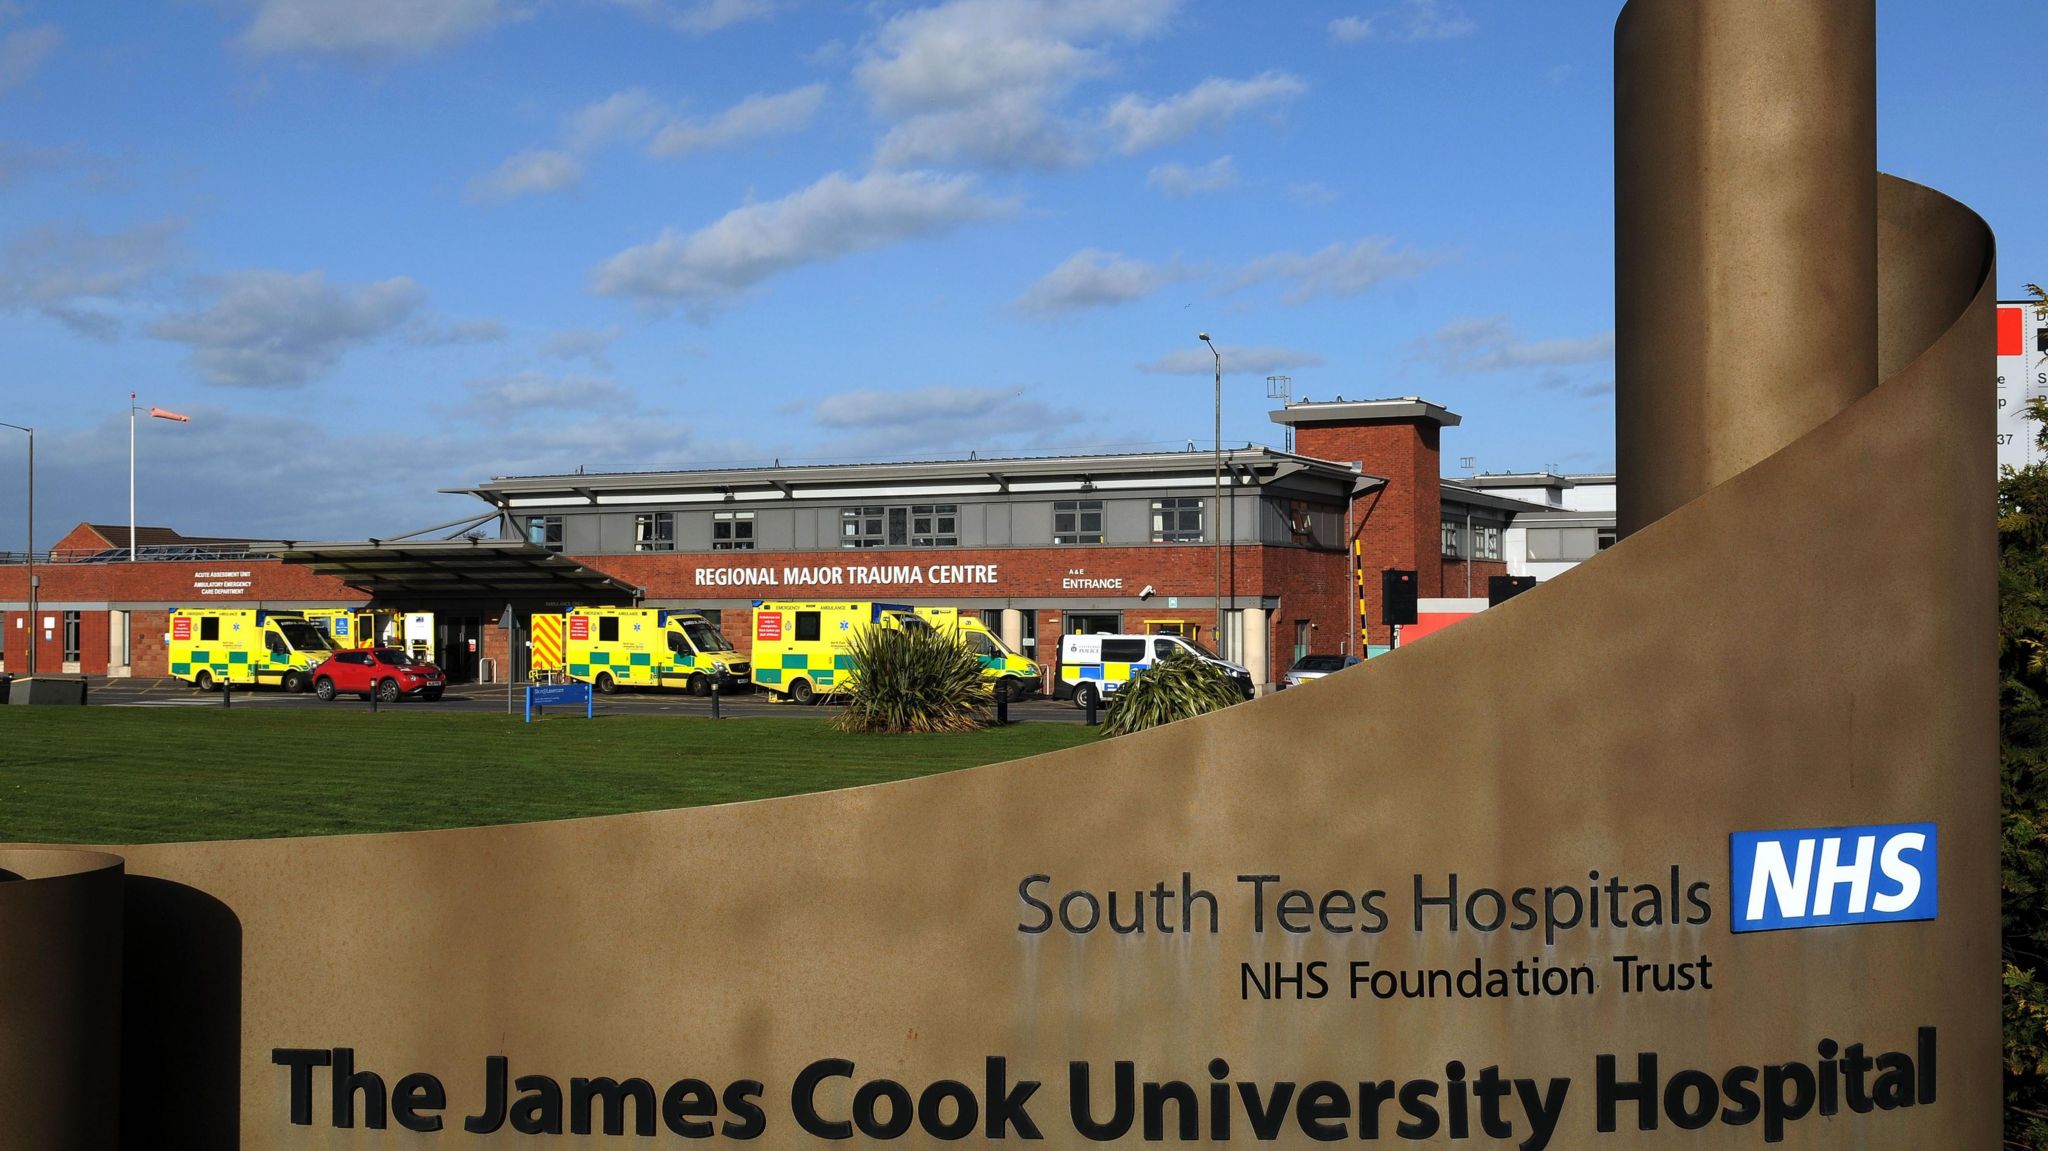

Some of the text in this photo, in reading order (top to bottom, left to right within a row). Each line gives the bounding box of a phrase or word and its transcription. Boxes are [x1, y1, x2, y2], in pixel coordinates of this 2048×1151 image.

[695, 565, 998, 586] REGIONAL MAJOR TRAUMA CENTRE
[1063, 578, 1123, 589] ENTRANCE
[1018, 865, 1712, 946] South Tees Hospitals
[1746, 832, 1925, 921] NHS
[1241, 953, 1713, 1000] NHS Foundation Trust
[272, 1026, 1938, 1151] The James Cook University Hospital
